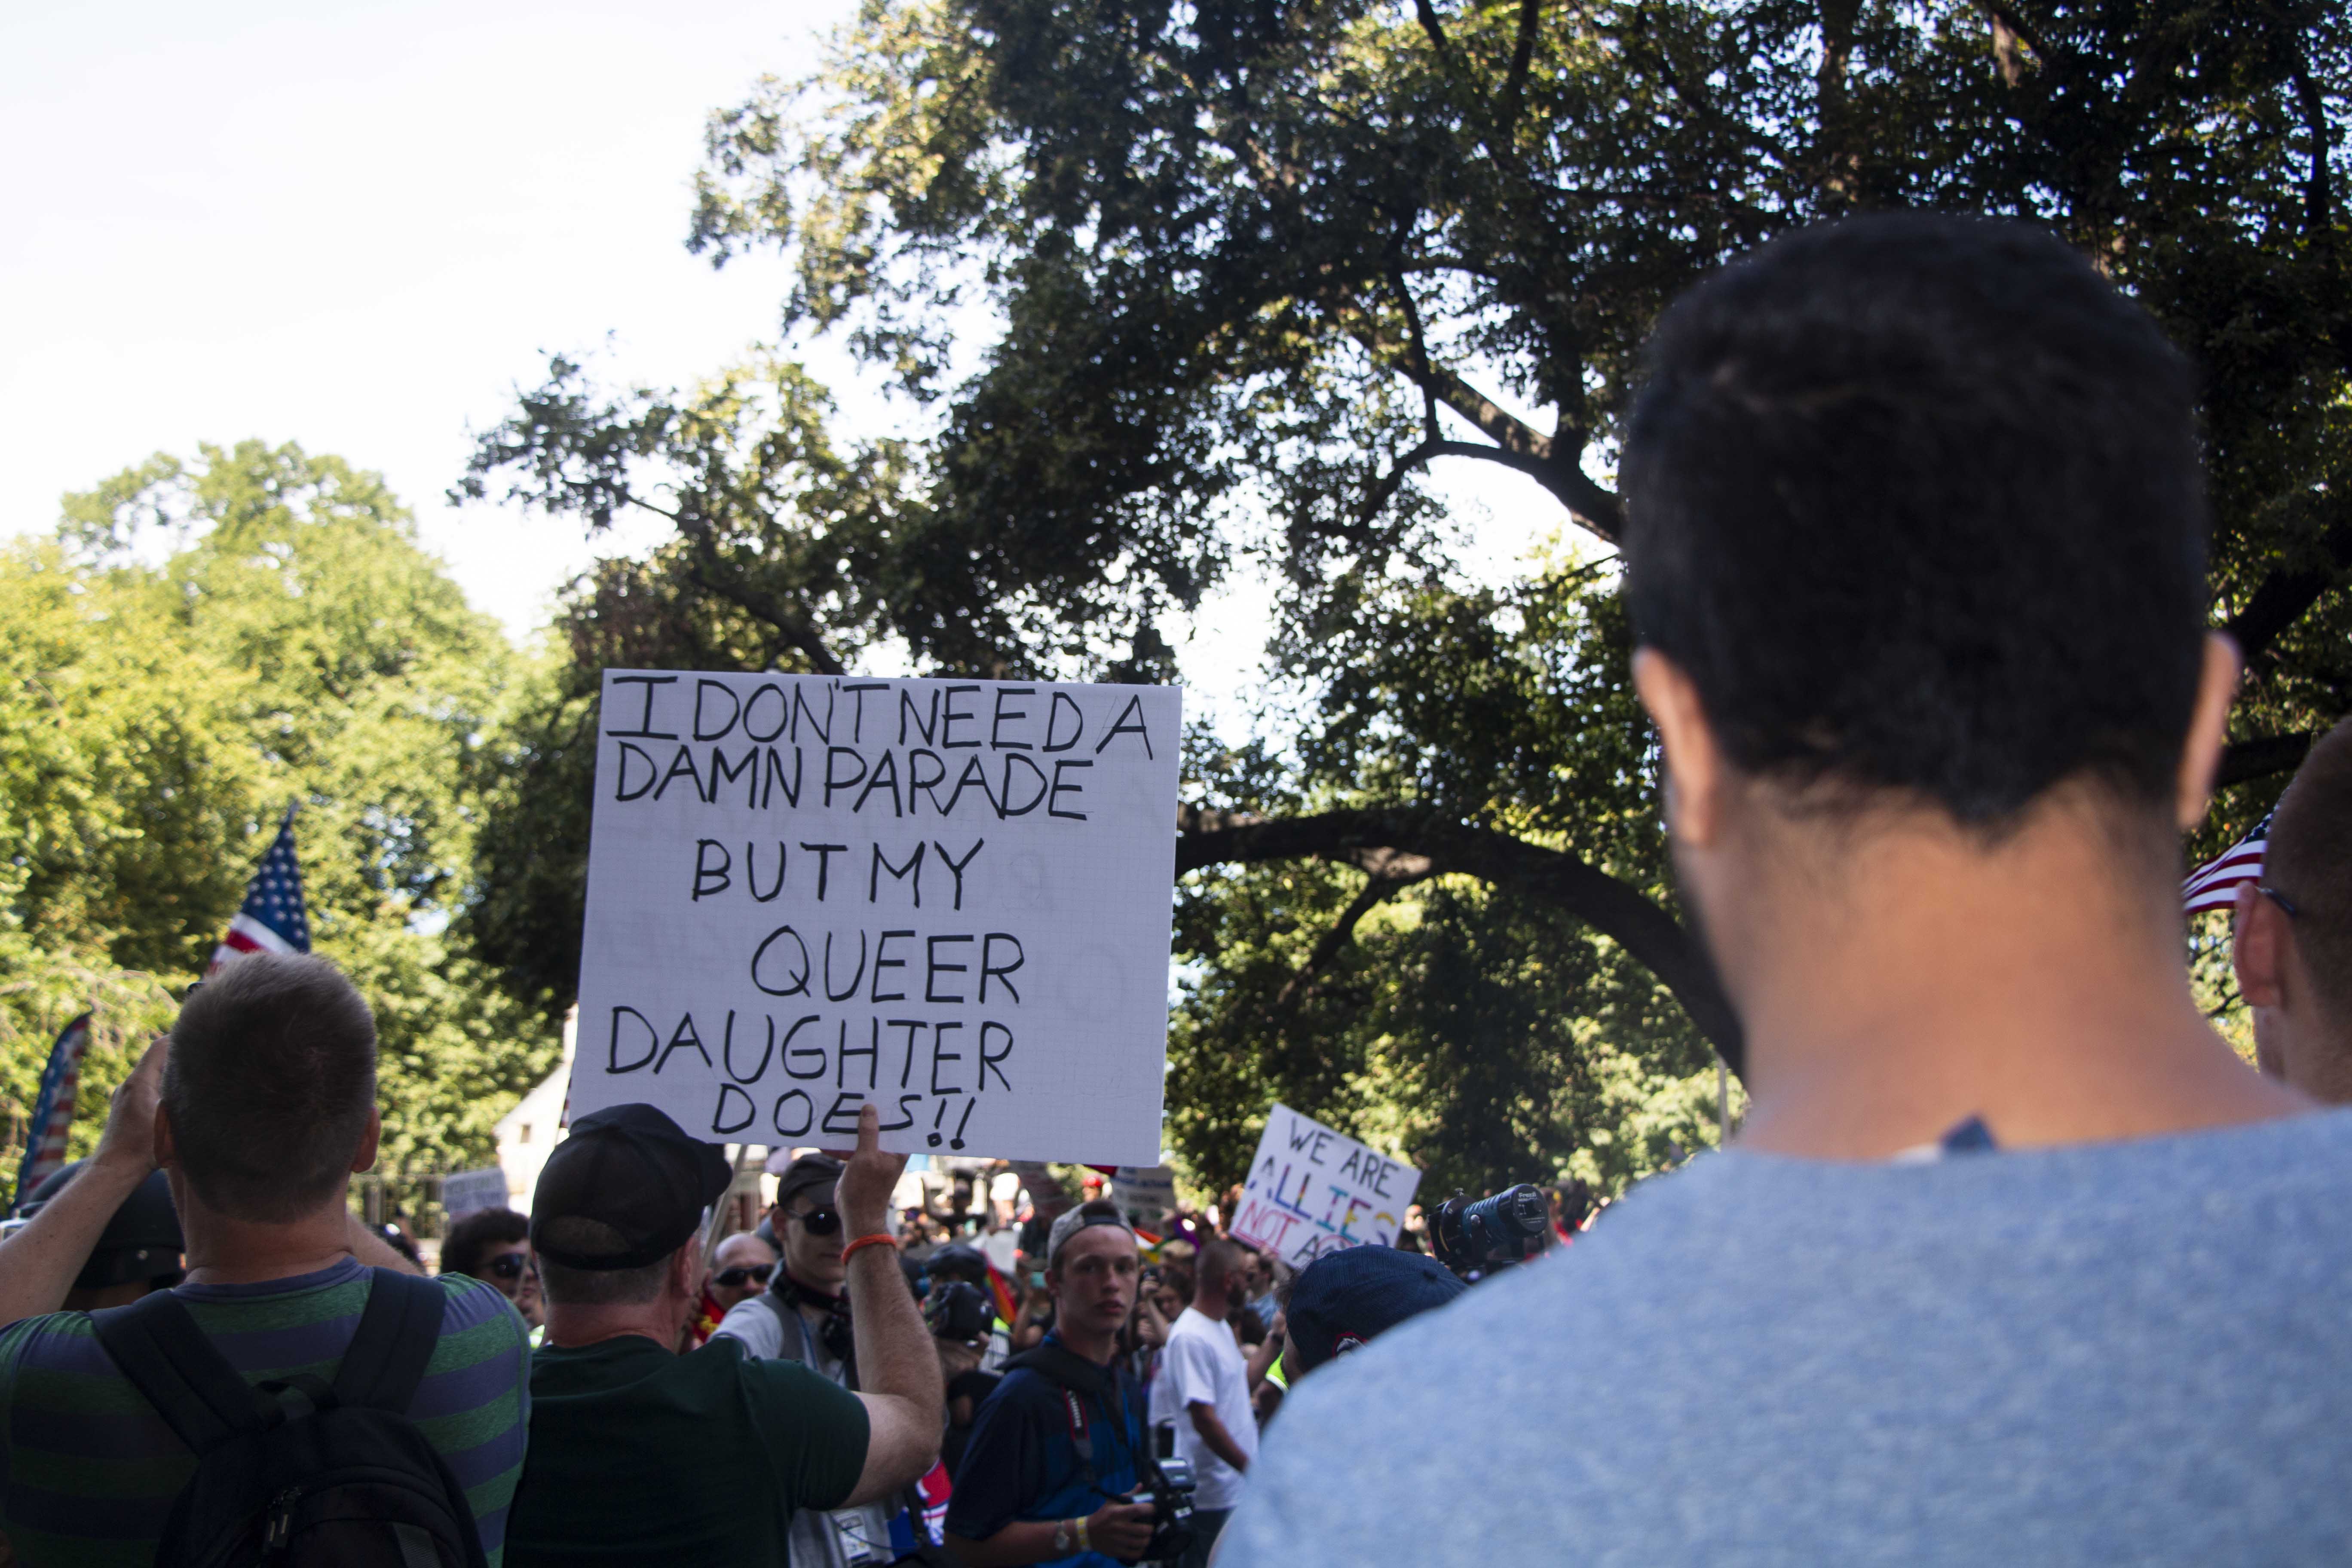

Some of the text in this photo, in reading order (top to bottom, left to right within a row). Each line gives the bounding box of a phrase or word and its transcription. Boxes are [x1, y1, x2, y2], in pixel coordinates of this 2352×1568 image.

[606, 676, 1152, 760] I DON'T NEED A
[616, 741, 1093, 820] DAMN PARADE
[692, 838, 983, 910] BUT MY
[752, 925, 1024, 1004] QUEER
[606, 1006, 1013, 1095] DAUGHTER
[712, 1083, 977, 1150] DOES!!
[1289, 1118, 1399, 1199] WE ARE
[1235, 1201, 1301, 1249] NOT
